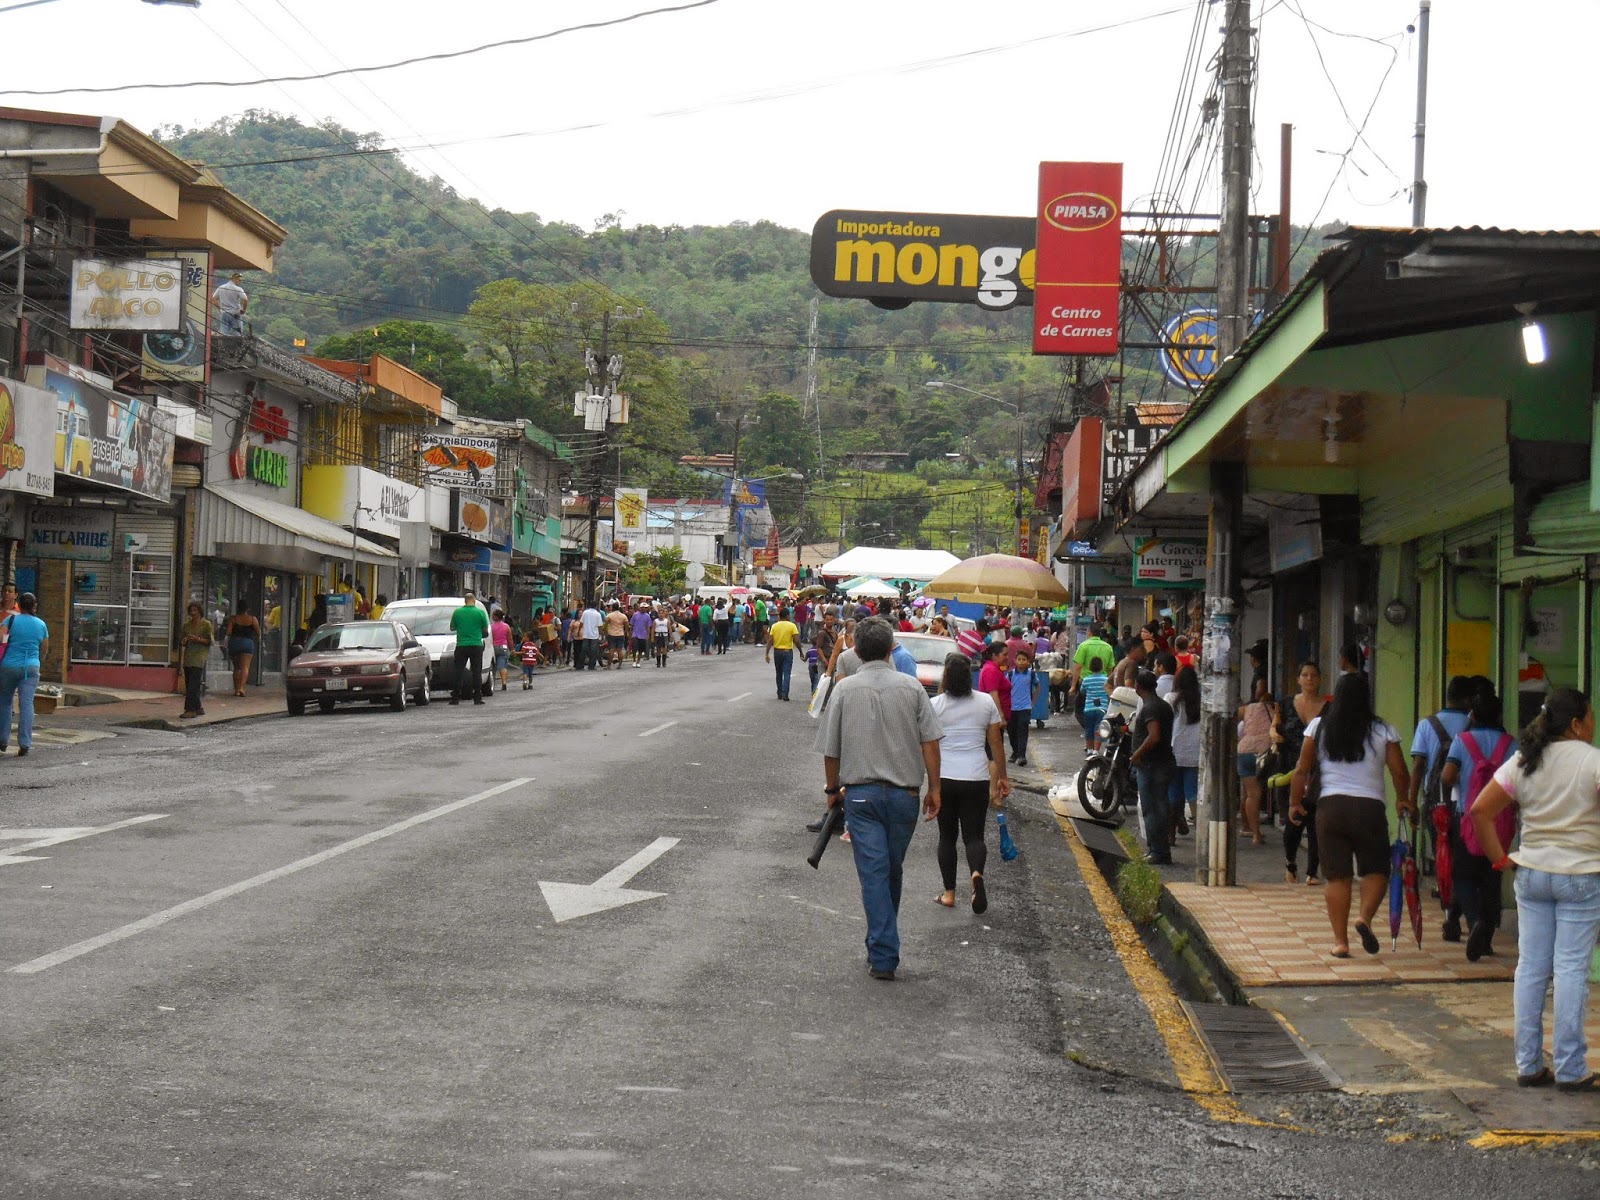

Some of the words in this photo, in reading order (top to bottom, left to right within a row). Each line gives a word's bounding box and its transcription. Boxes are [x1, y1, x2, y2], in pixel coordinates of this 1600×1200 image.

[1055, 204, 1108, 219] PIPASA
[836, 218, 941, 238] Importadora
[76, 270, 176, 292] POLLO
[87, 297, 164, 318] RICO
[1051, 306, 1102, 320] Centro
[1040, 324, 1059, 337] de
[1061, 324, 1113, 338] Carnes
[422, 435, 496, 449] DISTRIBUIDORA
[253, 446, 288, 488] CARIBE
[32, 529, 108, 548] NETCARIBE
